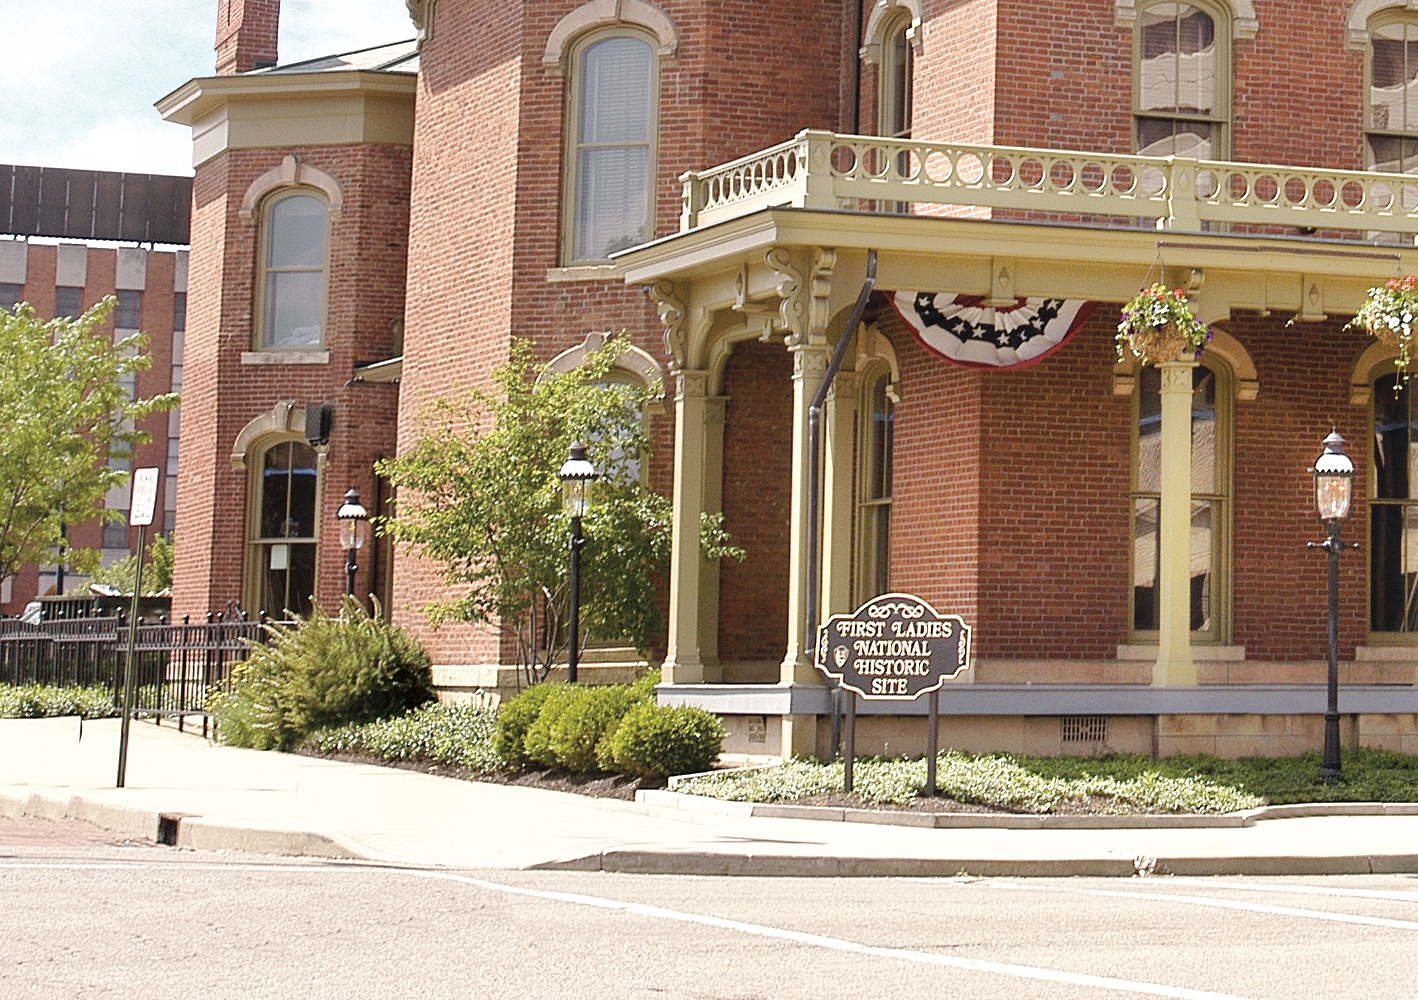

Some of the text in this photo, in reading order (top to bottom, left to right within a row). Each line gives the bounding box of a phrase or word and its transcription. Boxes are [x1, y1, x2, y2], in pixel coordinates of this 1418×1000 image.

[836, 621, 953, 638] FIRST LADIES
[853, 640, 932, 657] NATIONAL
[853, 659, 930, 676] HISTORIC
[871, 678, 908, 695] SITE
